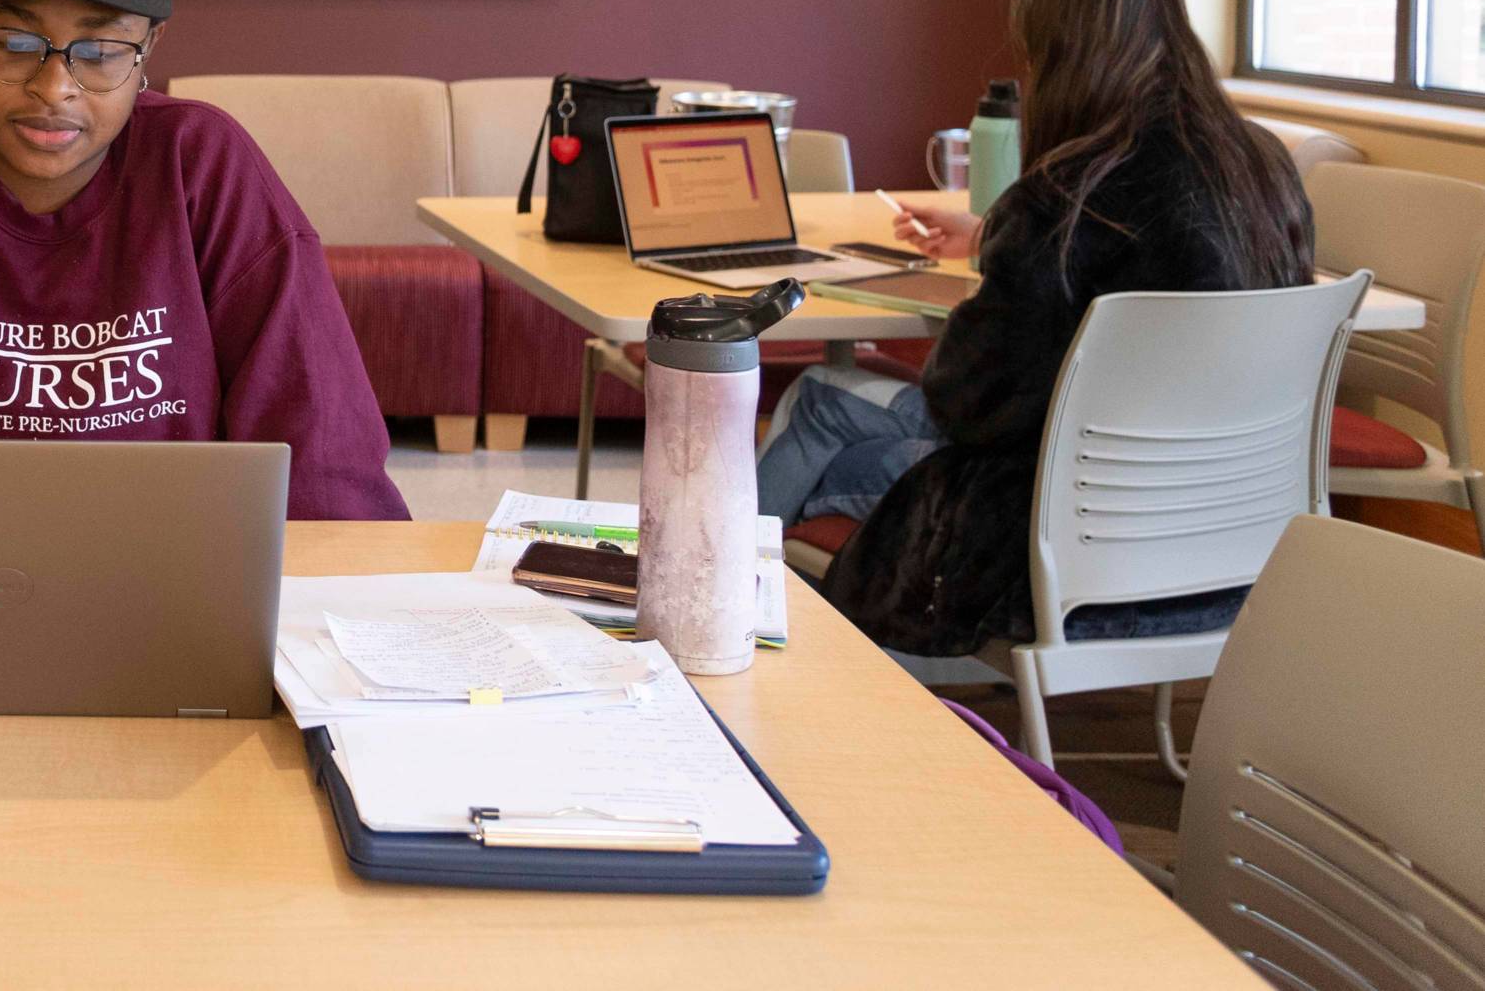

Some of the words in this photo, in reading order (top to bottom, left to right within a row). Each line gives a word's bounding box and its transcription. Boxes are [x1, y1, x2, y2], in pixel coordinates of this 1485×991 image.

[53, 307, 167, 349] BOBCAT
[18, 408, 145, 433] PRE-NURSING
[149, 400, 187, 419] ORG
